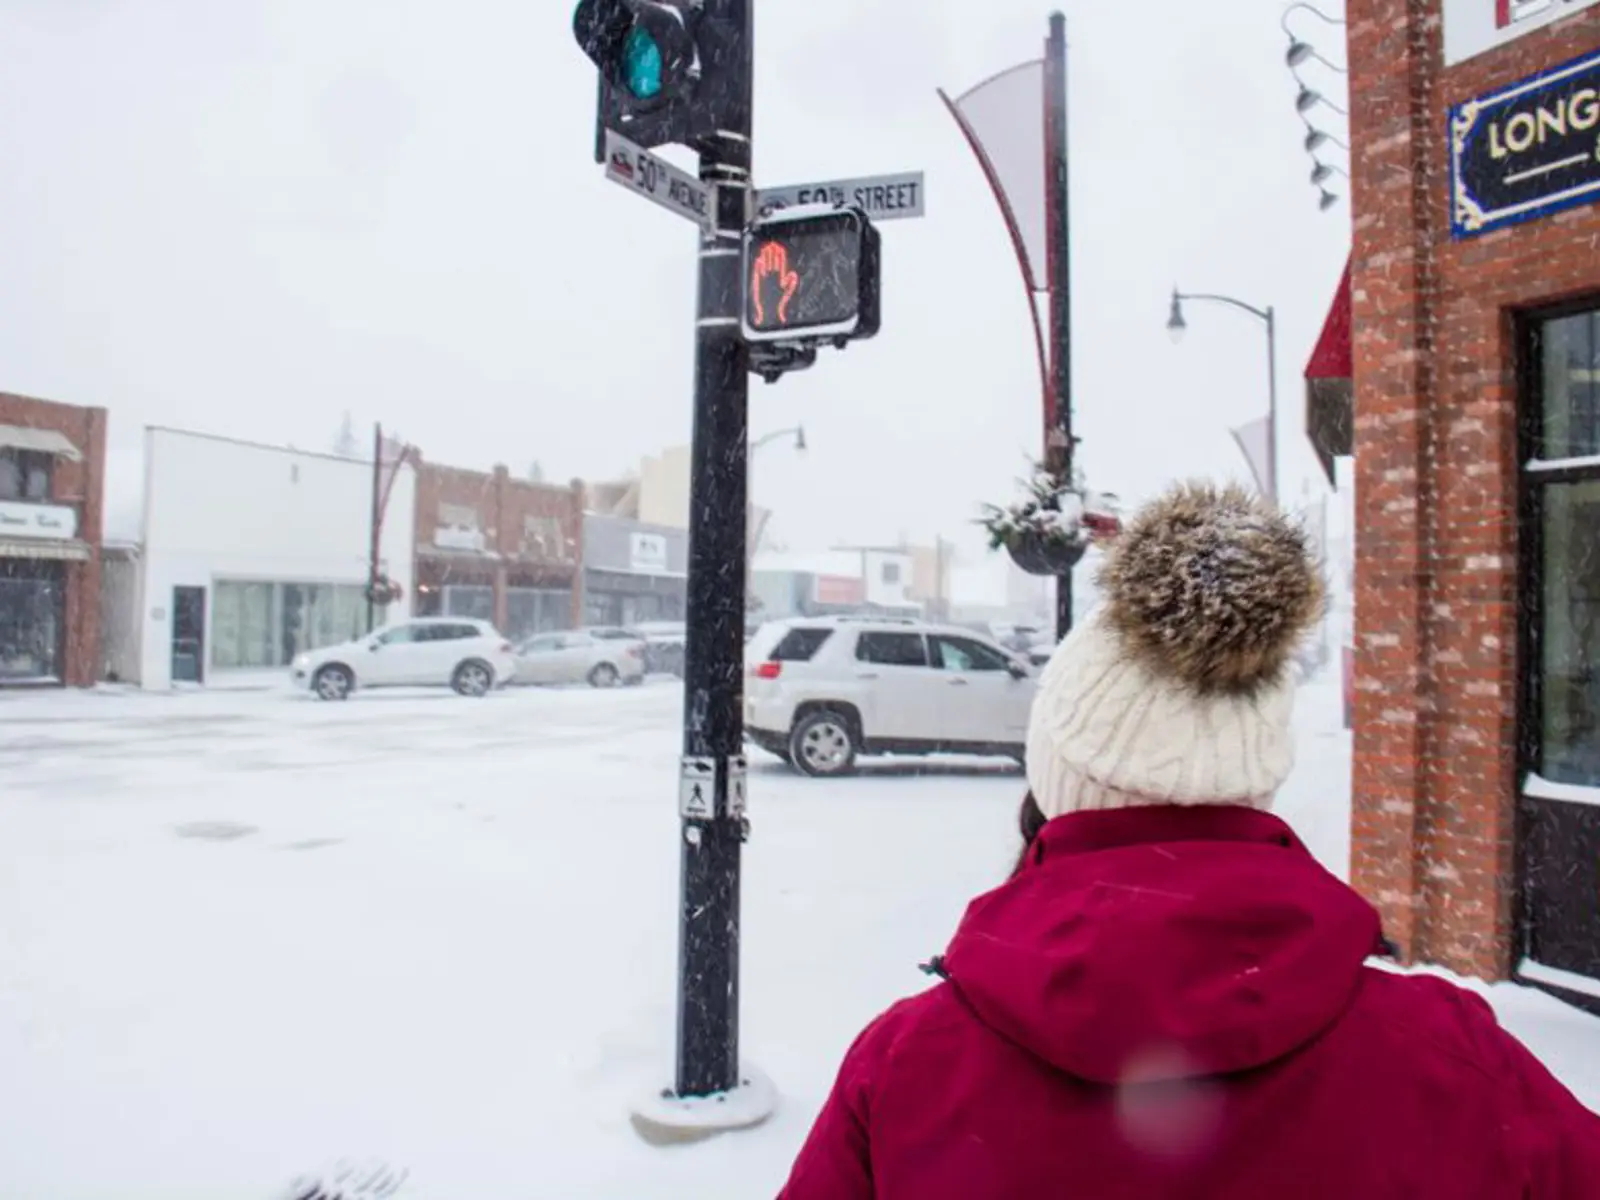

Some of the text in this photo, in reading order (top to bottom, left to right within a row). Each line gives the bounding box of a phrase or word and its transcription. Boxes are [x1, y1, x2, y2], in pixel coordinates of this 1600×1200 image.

[1488, 88, 1600, 159] LONG
[637, 153, 708, 217] 50TH AVENUE
[853, 181, 919, 211] STREET
